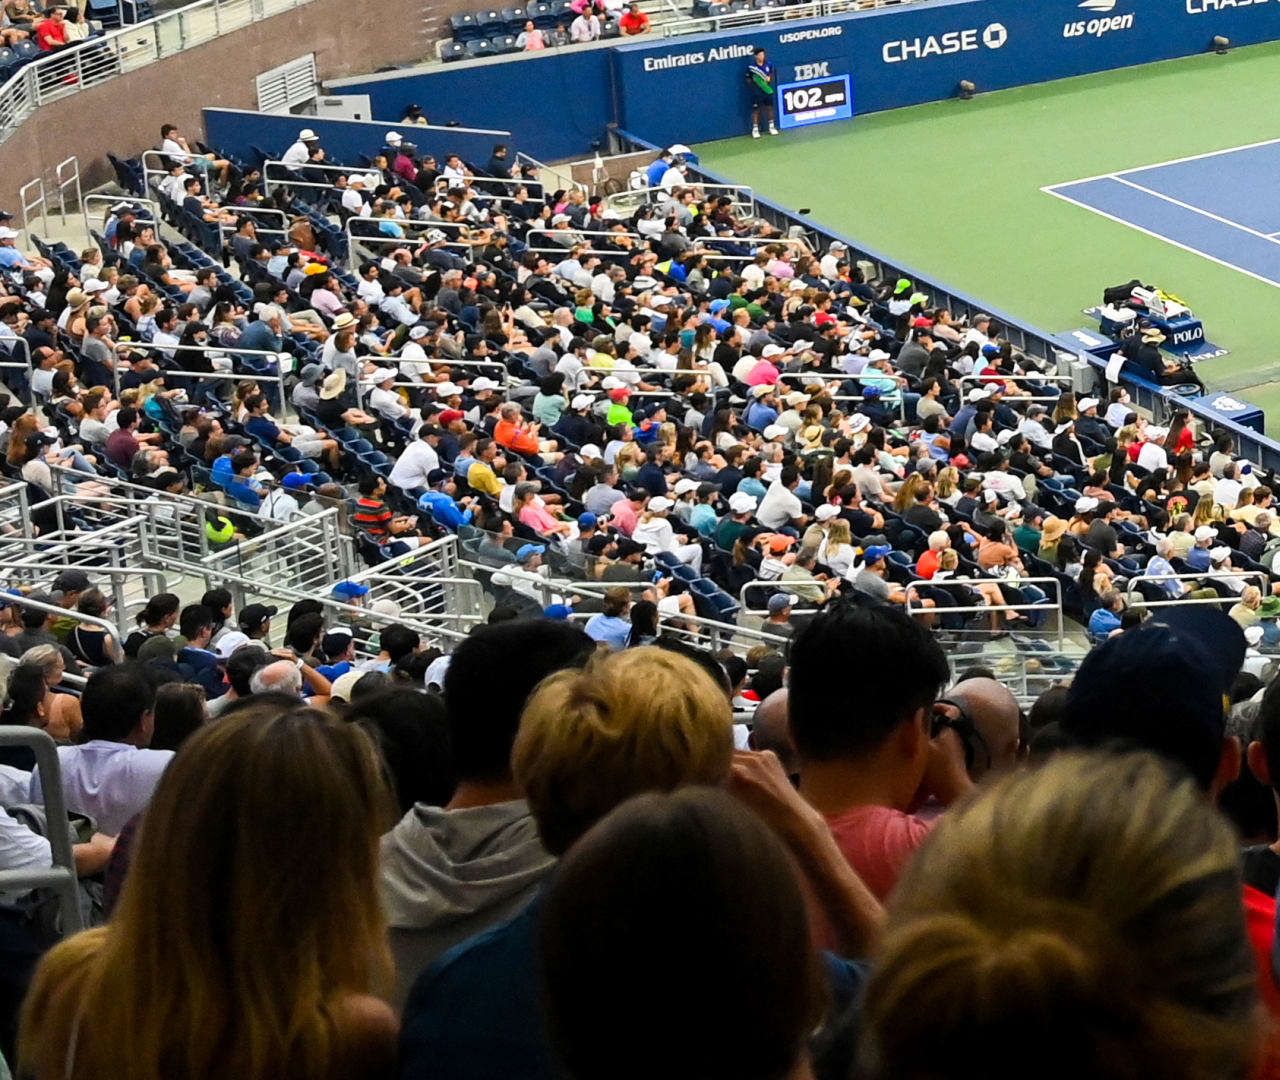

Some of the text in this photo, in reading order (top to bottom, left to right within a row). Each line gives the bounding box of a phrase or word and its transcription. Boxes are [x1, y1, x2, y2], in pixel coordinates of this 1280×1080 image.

[779, 26, 842, 44] USOPEN.ORG
[882, 28, 979, 63] CHASE
[644, 43, 755, 72] Emirates Airline
[794, 61, 831, 81] IBM
[783, 87, 822, 111] 102
[1173, 327, 1203, 345] POLO
